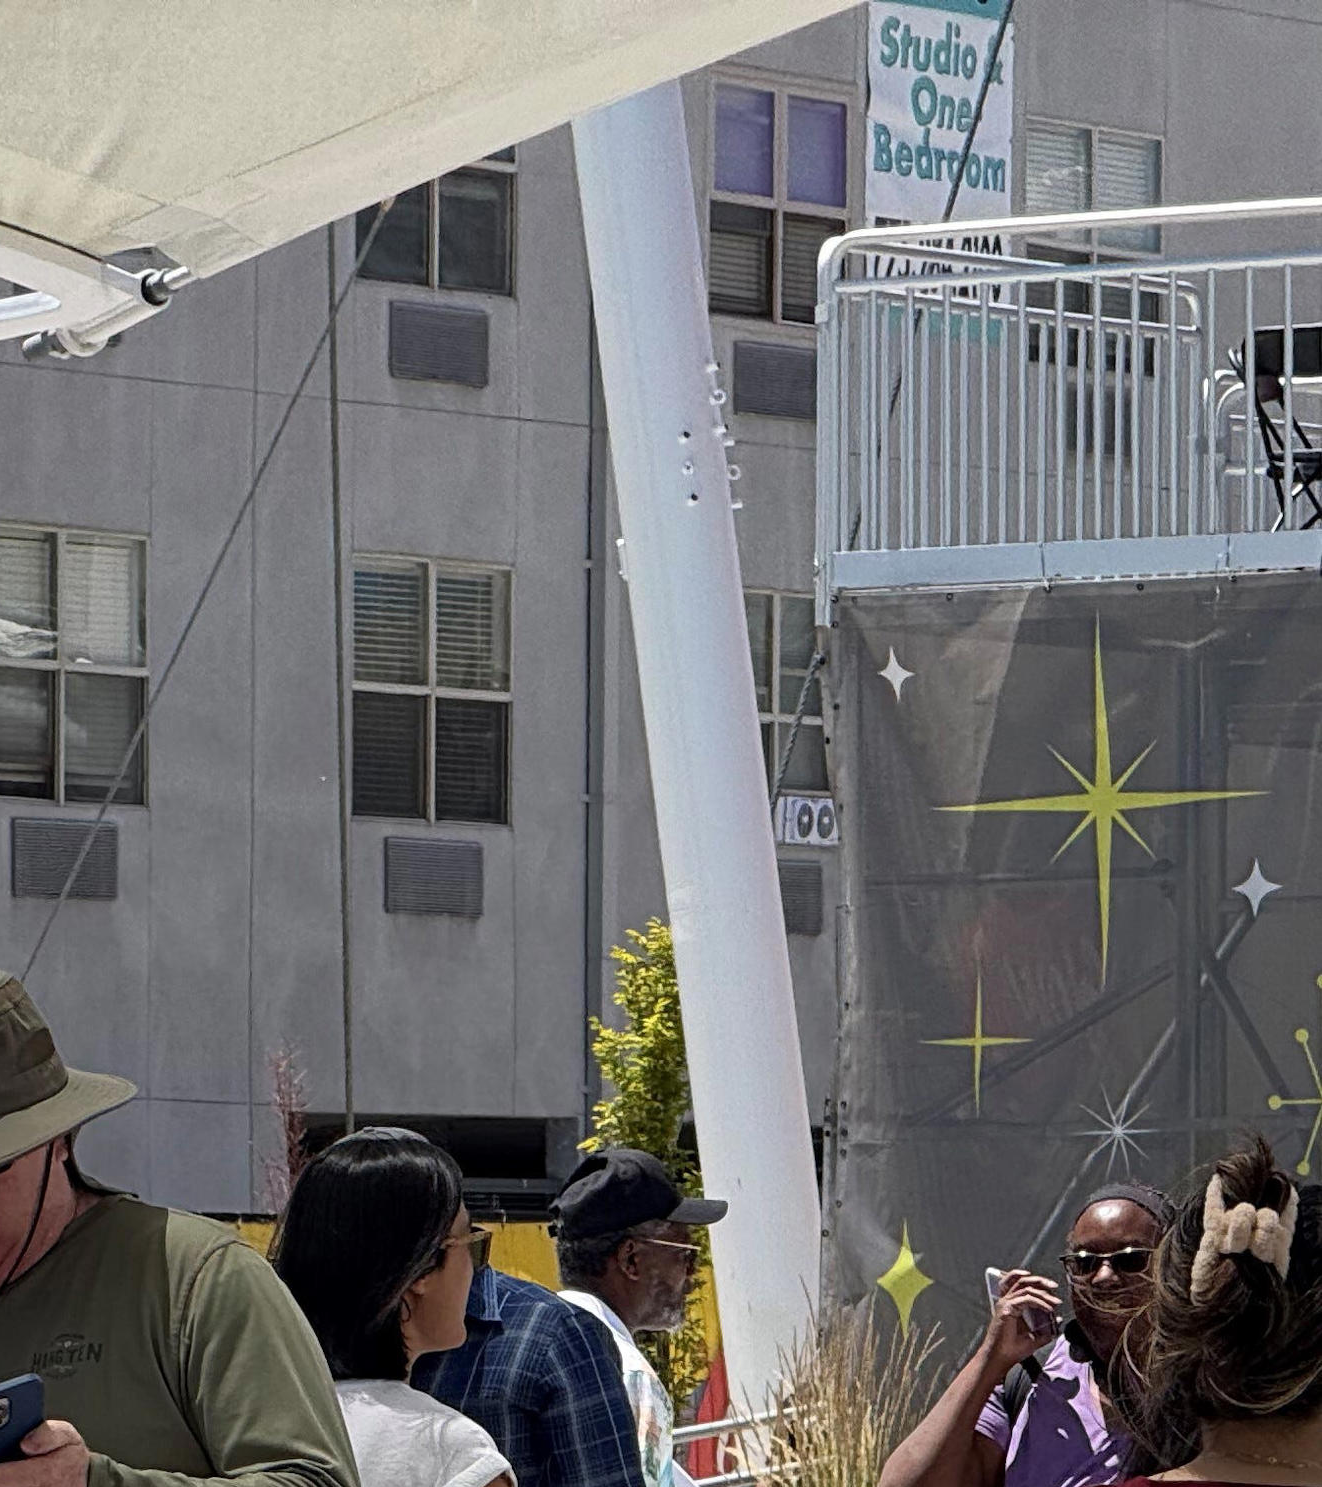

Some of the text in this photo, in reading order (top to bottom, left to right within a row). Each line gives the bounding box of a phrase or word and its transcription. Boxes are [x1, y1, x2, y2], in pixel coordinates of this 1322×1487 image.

[879, 15, 977, 80] Studio
[910, 75, 981, 133] One
[872, 122, 1006, 194] Bedroom
